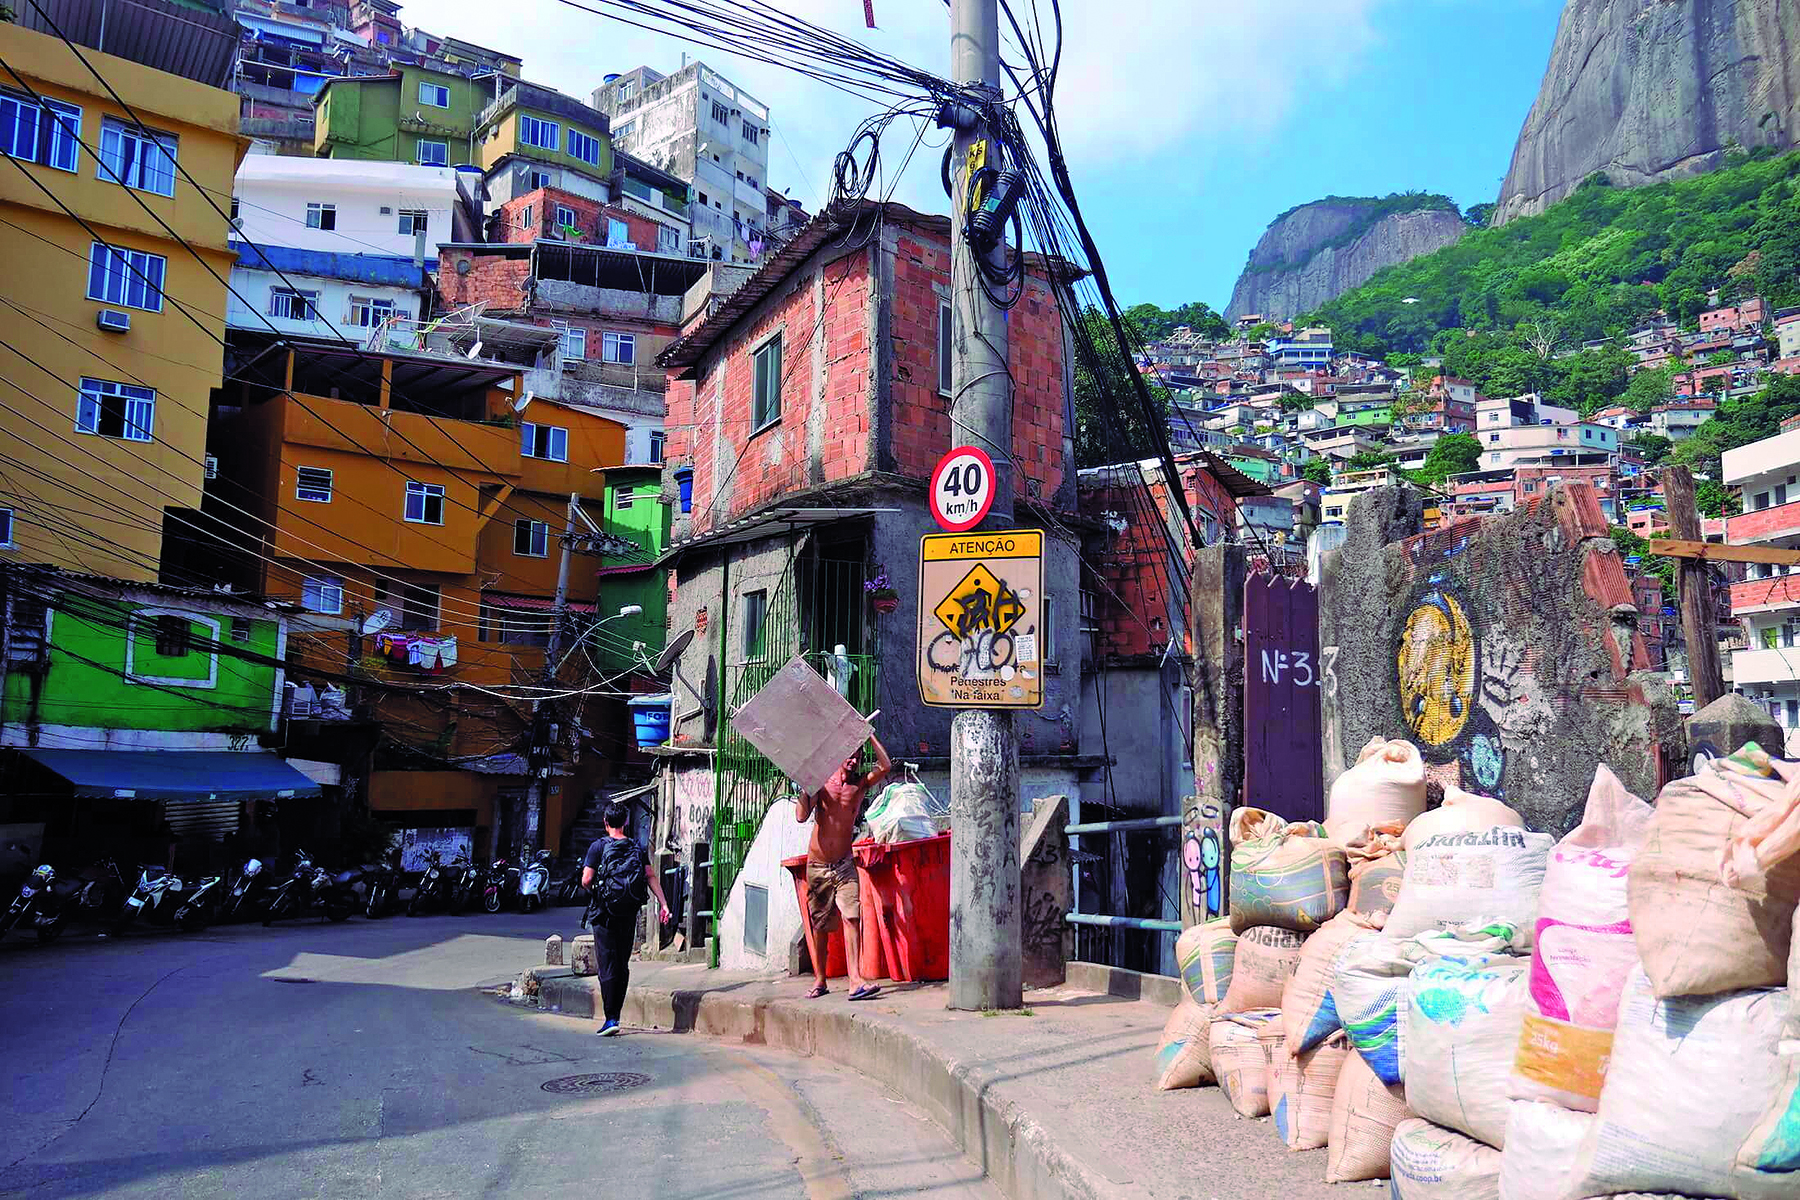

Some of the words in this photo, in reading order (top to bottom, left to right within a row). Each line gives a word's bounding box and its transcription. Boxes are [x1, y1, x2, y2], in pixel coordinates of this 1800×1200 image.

[943, 463, 982, 497] 40
[945, 499, 978, 516] km/h
[949, 537, 1015, 555] ATENÇÃO
